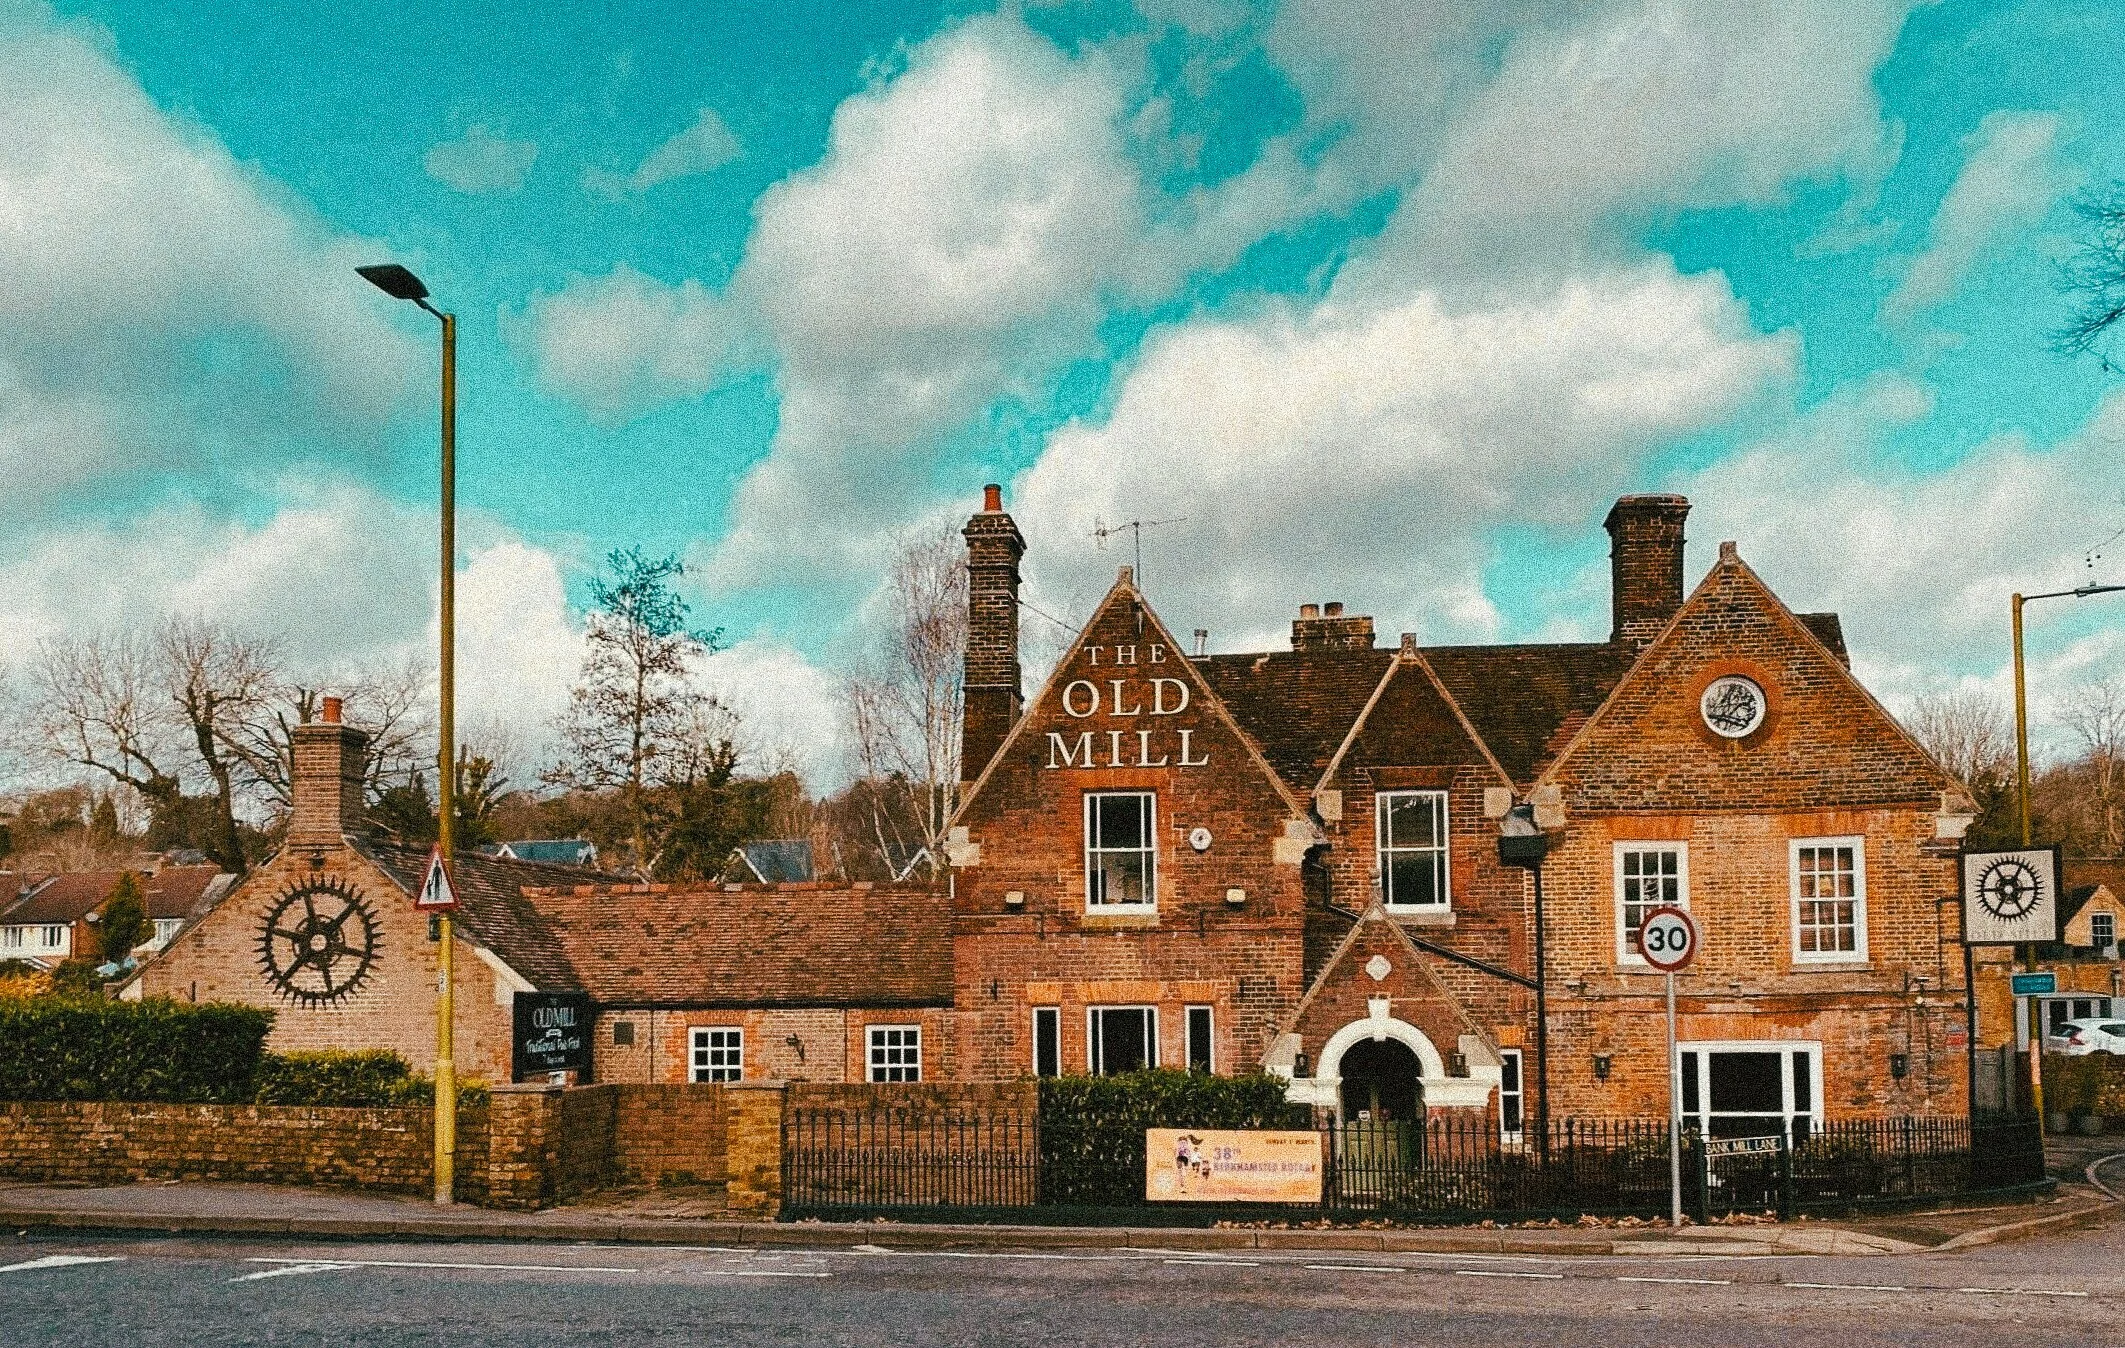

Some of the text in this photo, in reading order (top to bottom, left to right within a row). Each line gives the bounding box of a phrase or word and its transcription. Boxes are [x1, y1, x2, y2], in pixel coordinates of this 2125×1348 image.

[1083, 643, 1167, 666] THE
[1062, 678, 1190, 718] OLD
[1045, 729, 1210, 769] MILL
[1647, 926, 1687, 952] 30
[533, 1006, 577, 1028] OLD MILL
[1706, 1138, 1776, 1154] BANK MILL LANE
